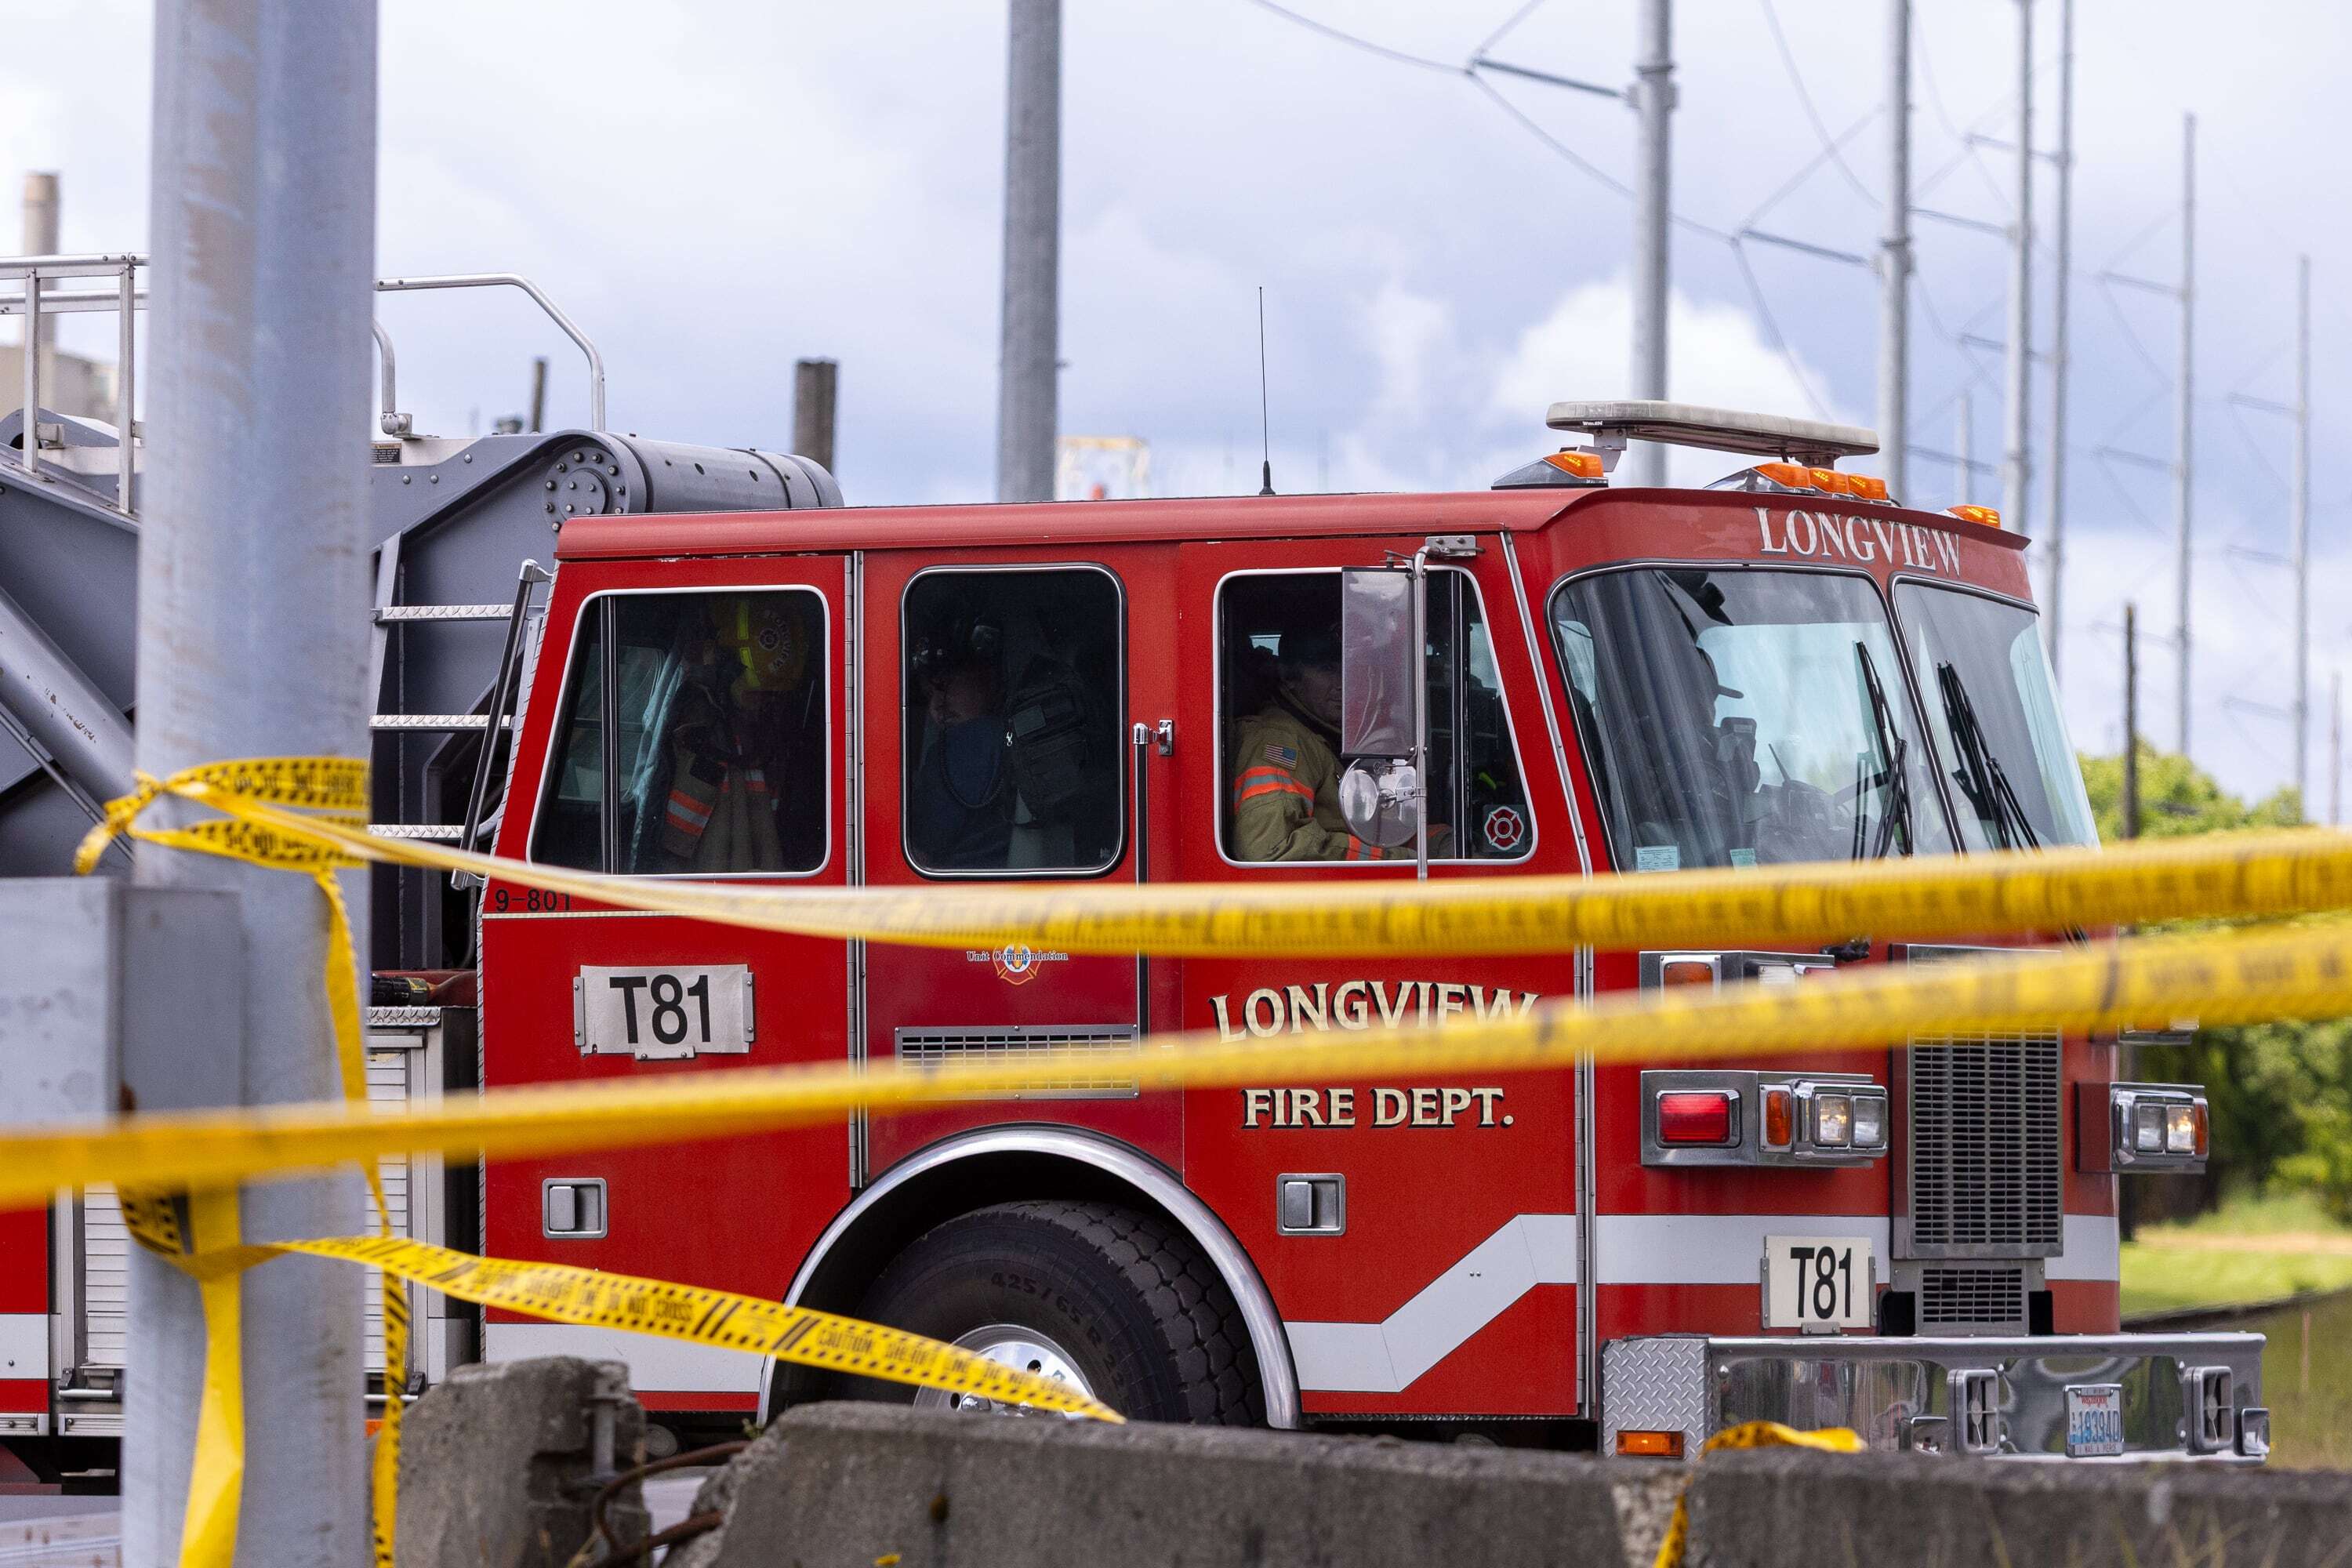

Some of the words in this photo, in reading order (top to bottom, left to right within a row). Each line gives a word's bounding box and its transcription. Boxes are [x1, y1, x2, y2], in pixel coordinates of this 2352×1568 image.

[1754, 506, 1962, 576] LONGVIEW
[495, 889, 572, 912] 9-801
[966, 950, 990, 962] Unit
[993, 950, 1069, 962] Commendation
[609, 974, 712, 1045] T81
[1209, 980, 1541, 1044] LONGVIEW
[1242, 1087, 1356, 1129] FIRE
[1371, 1087, 1515, 1129] DEPT.
[627, 1294, 647, 1316] NOT
[655, 1298, 693, 1321] CROSS
[1790, 1246, 1852, 1319] T81
